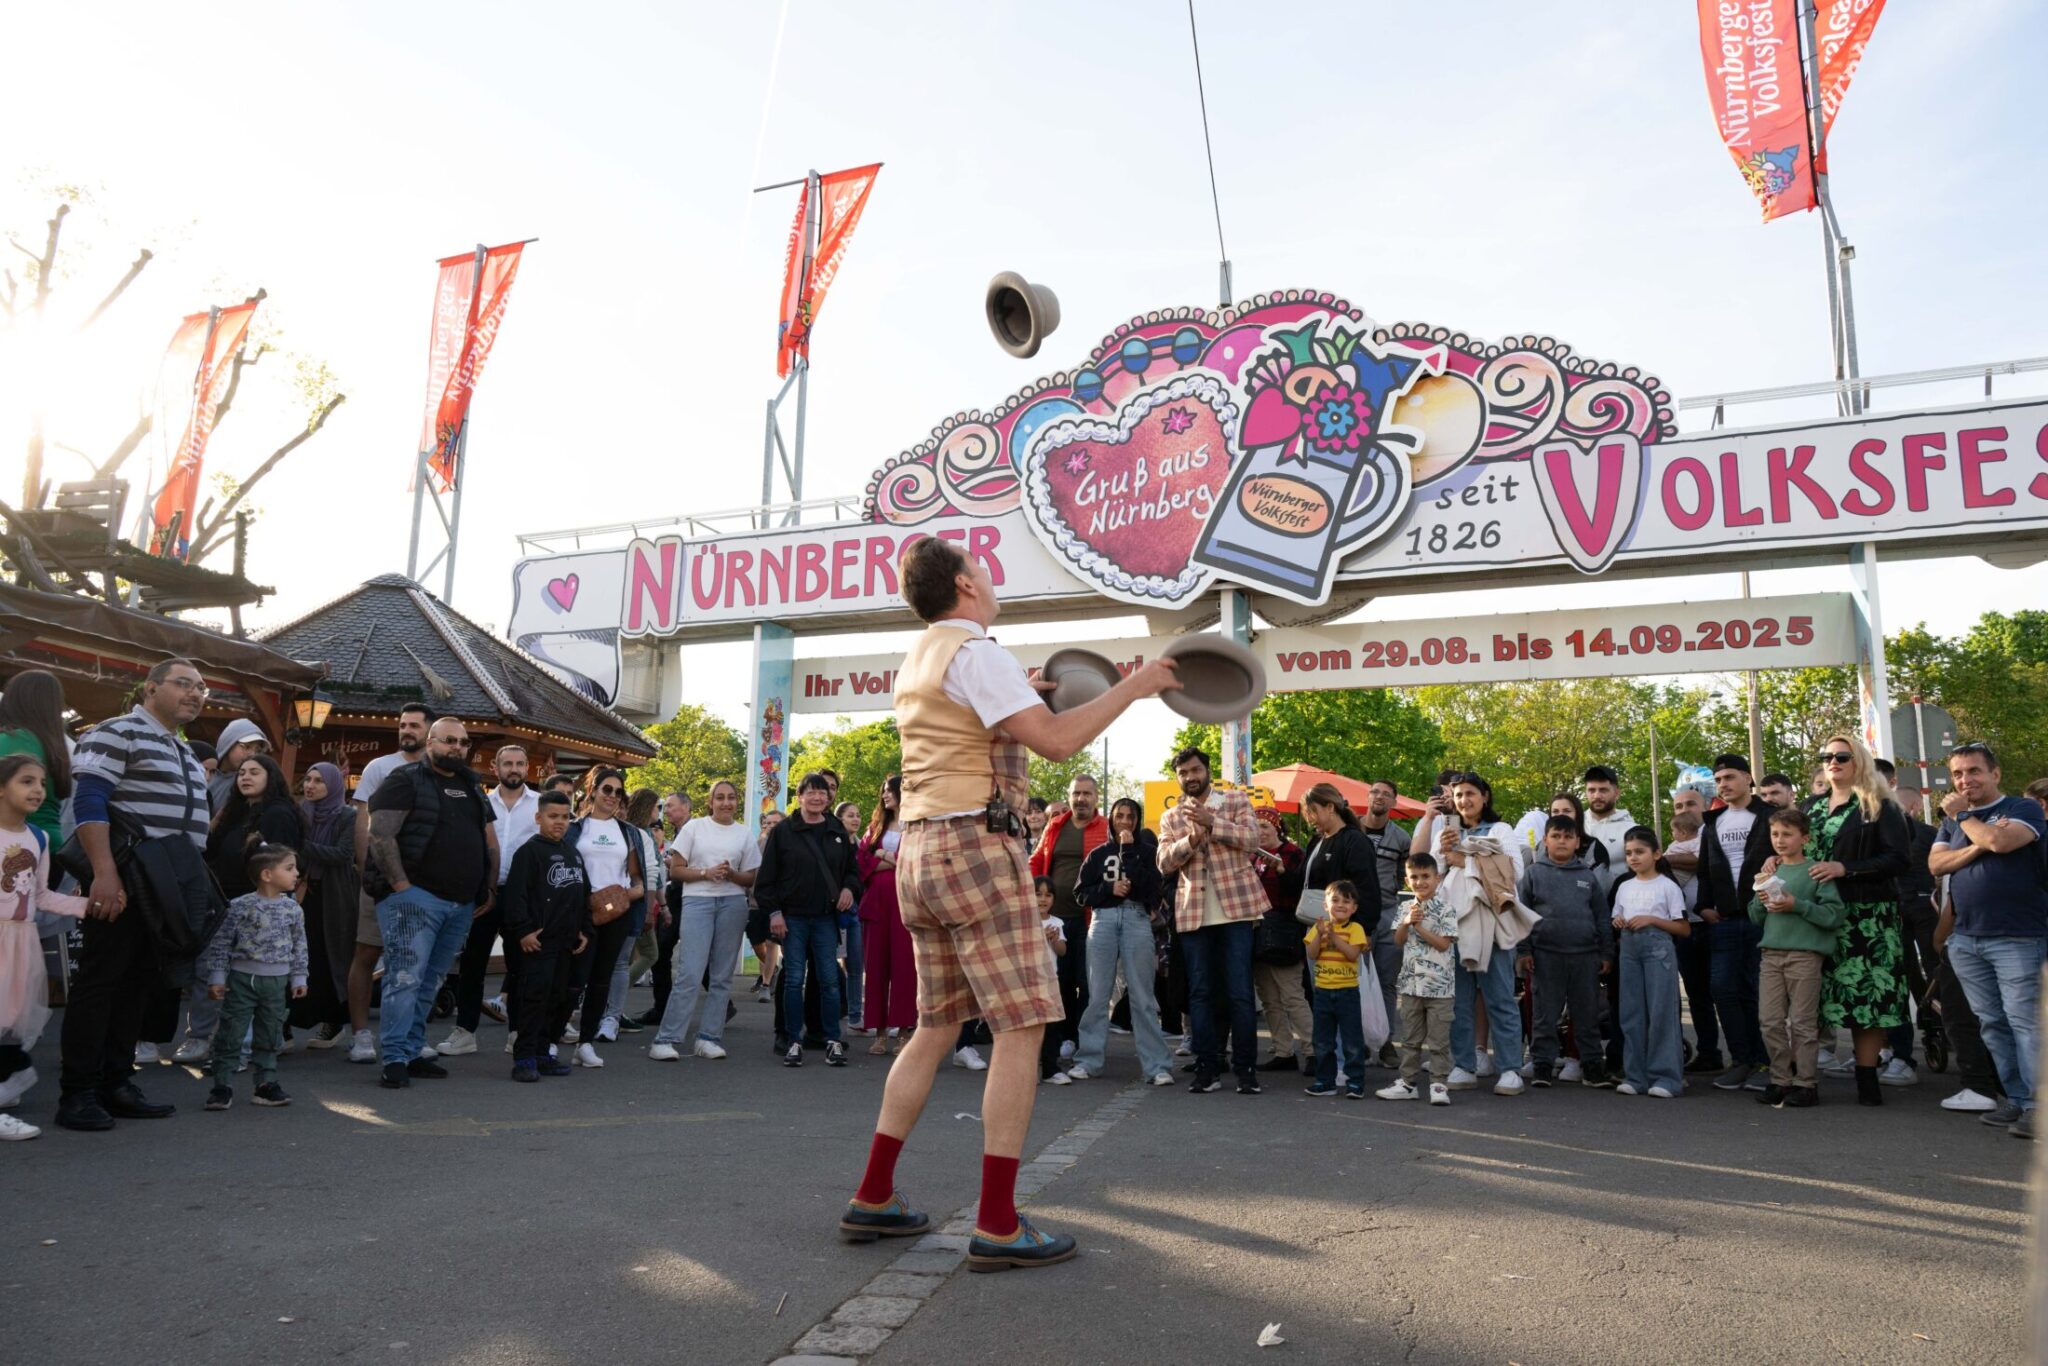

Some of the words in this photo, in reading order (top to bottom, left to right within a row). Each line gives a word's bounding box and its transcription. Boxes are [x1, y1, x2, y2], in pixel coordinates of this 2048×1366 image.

[1716, 0, 1751, 147] Nürnberge
[1075, 456, 1149, 506] Gruß
[1158, 443, 1210, 478] aus
[1248, 481, 1325, 513] Nürnberger
[1435, 474, 1521, 511] seit
[1088, 482, 1214, 536] Nürnberg
[1405, 519, 1502, 557] 1826
[1276, 649, 1352, 672] vom
[1362, 636, 1481, 668] 29.08.
[1492, 632, 1553, 662] bis
[1565, 616, 1815, 658] 14.09.2025
[804, 674, 844, 697] Ihr
[849, 670, 899, 695] Vol
